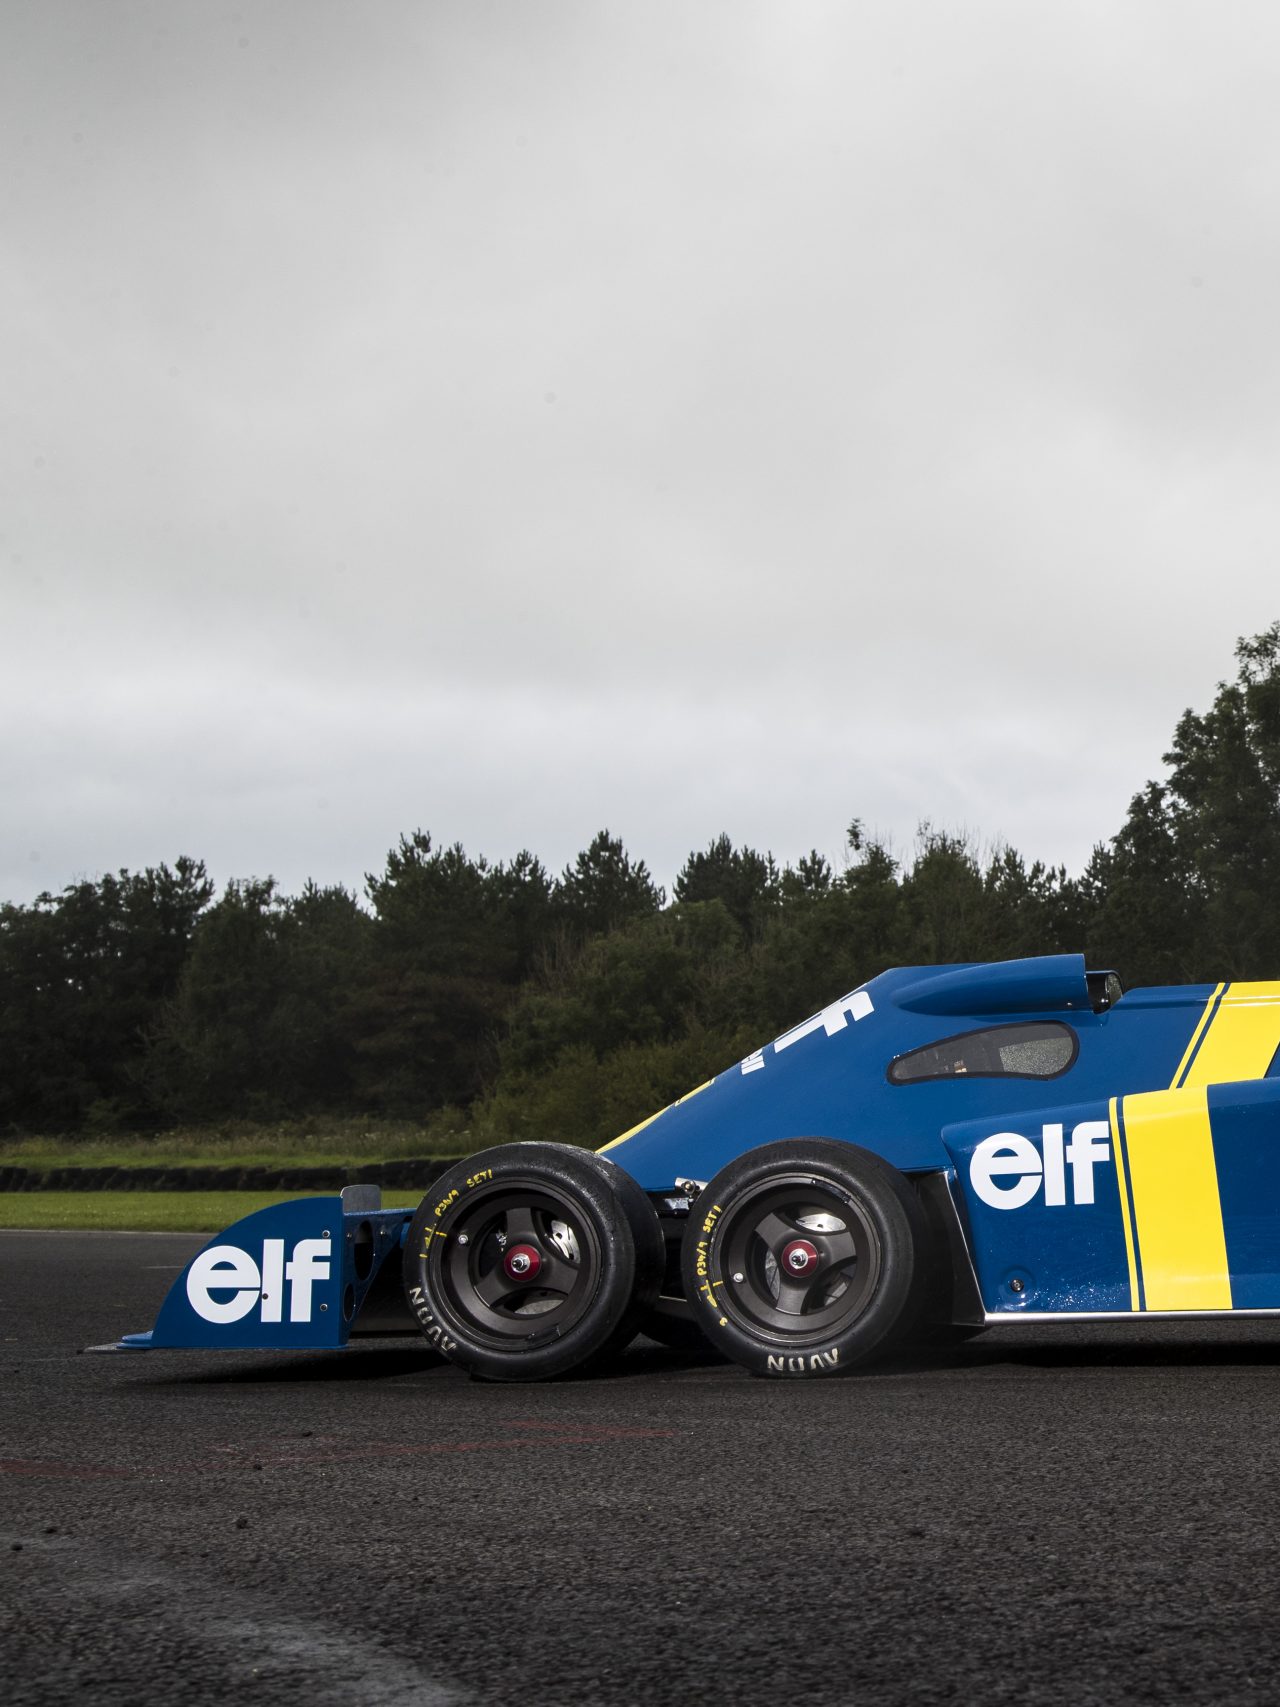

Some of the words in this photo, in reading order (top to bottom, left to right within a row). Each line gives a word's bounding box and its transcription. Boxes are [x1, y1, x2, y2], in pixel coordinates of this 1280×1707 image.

[969, 1120, 1110, 1210] elf
[187, 1238, 331, 1324] elf
[410, 1287, 457, 1352] AVON
[767, 1347, 840, 1372] AVON
